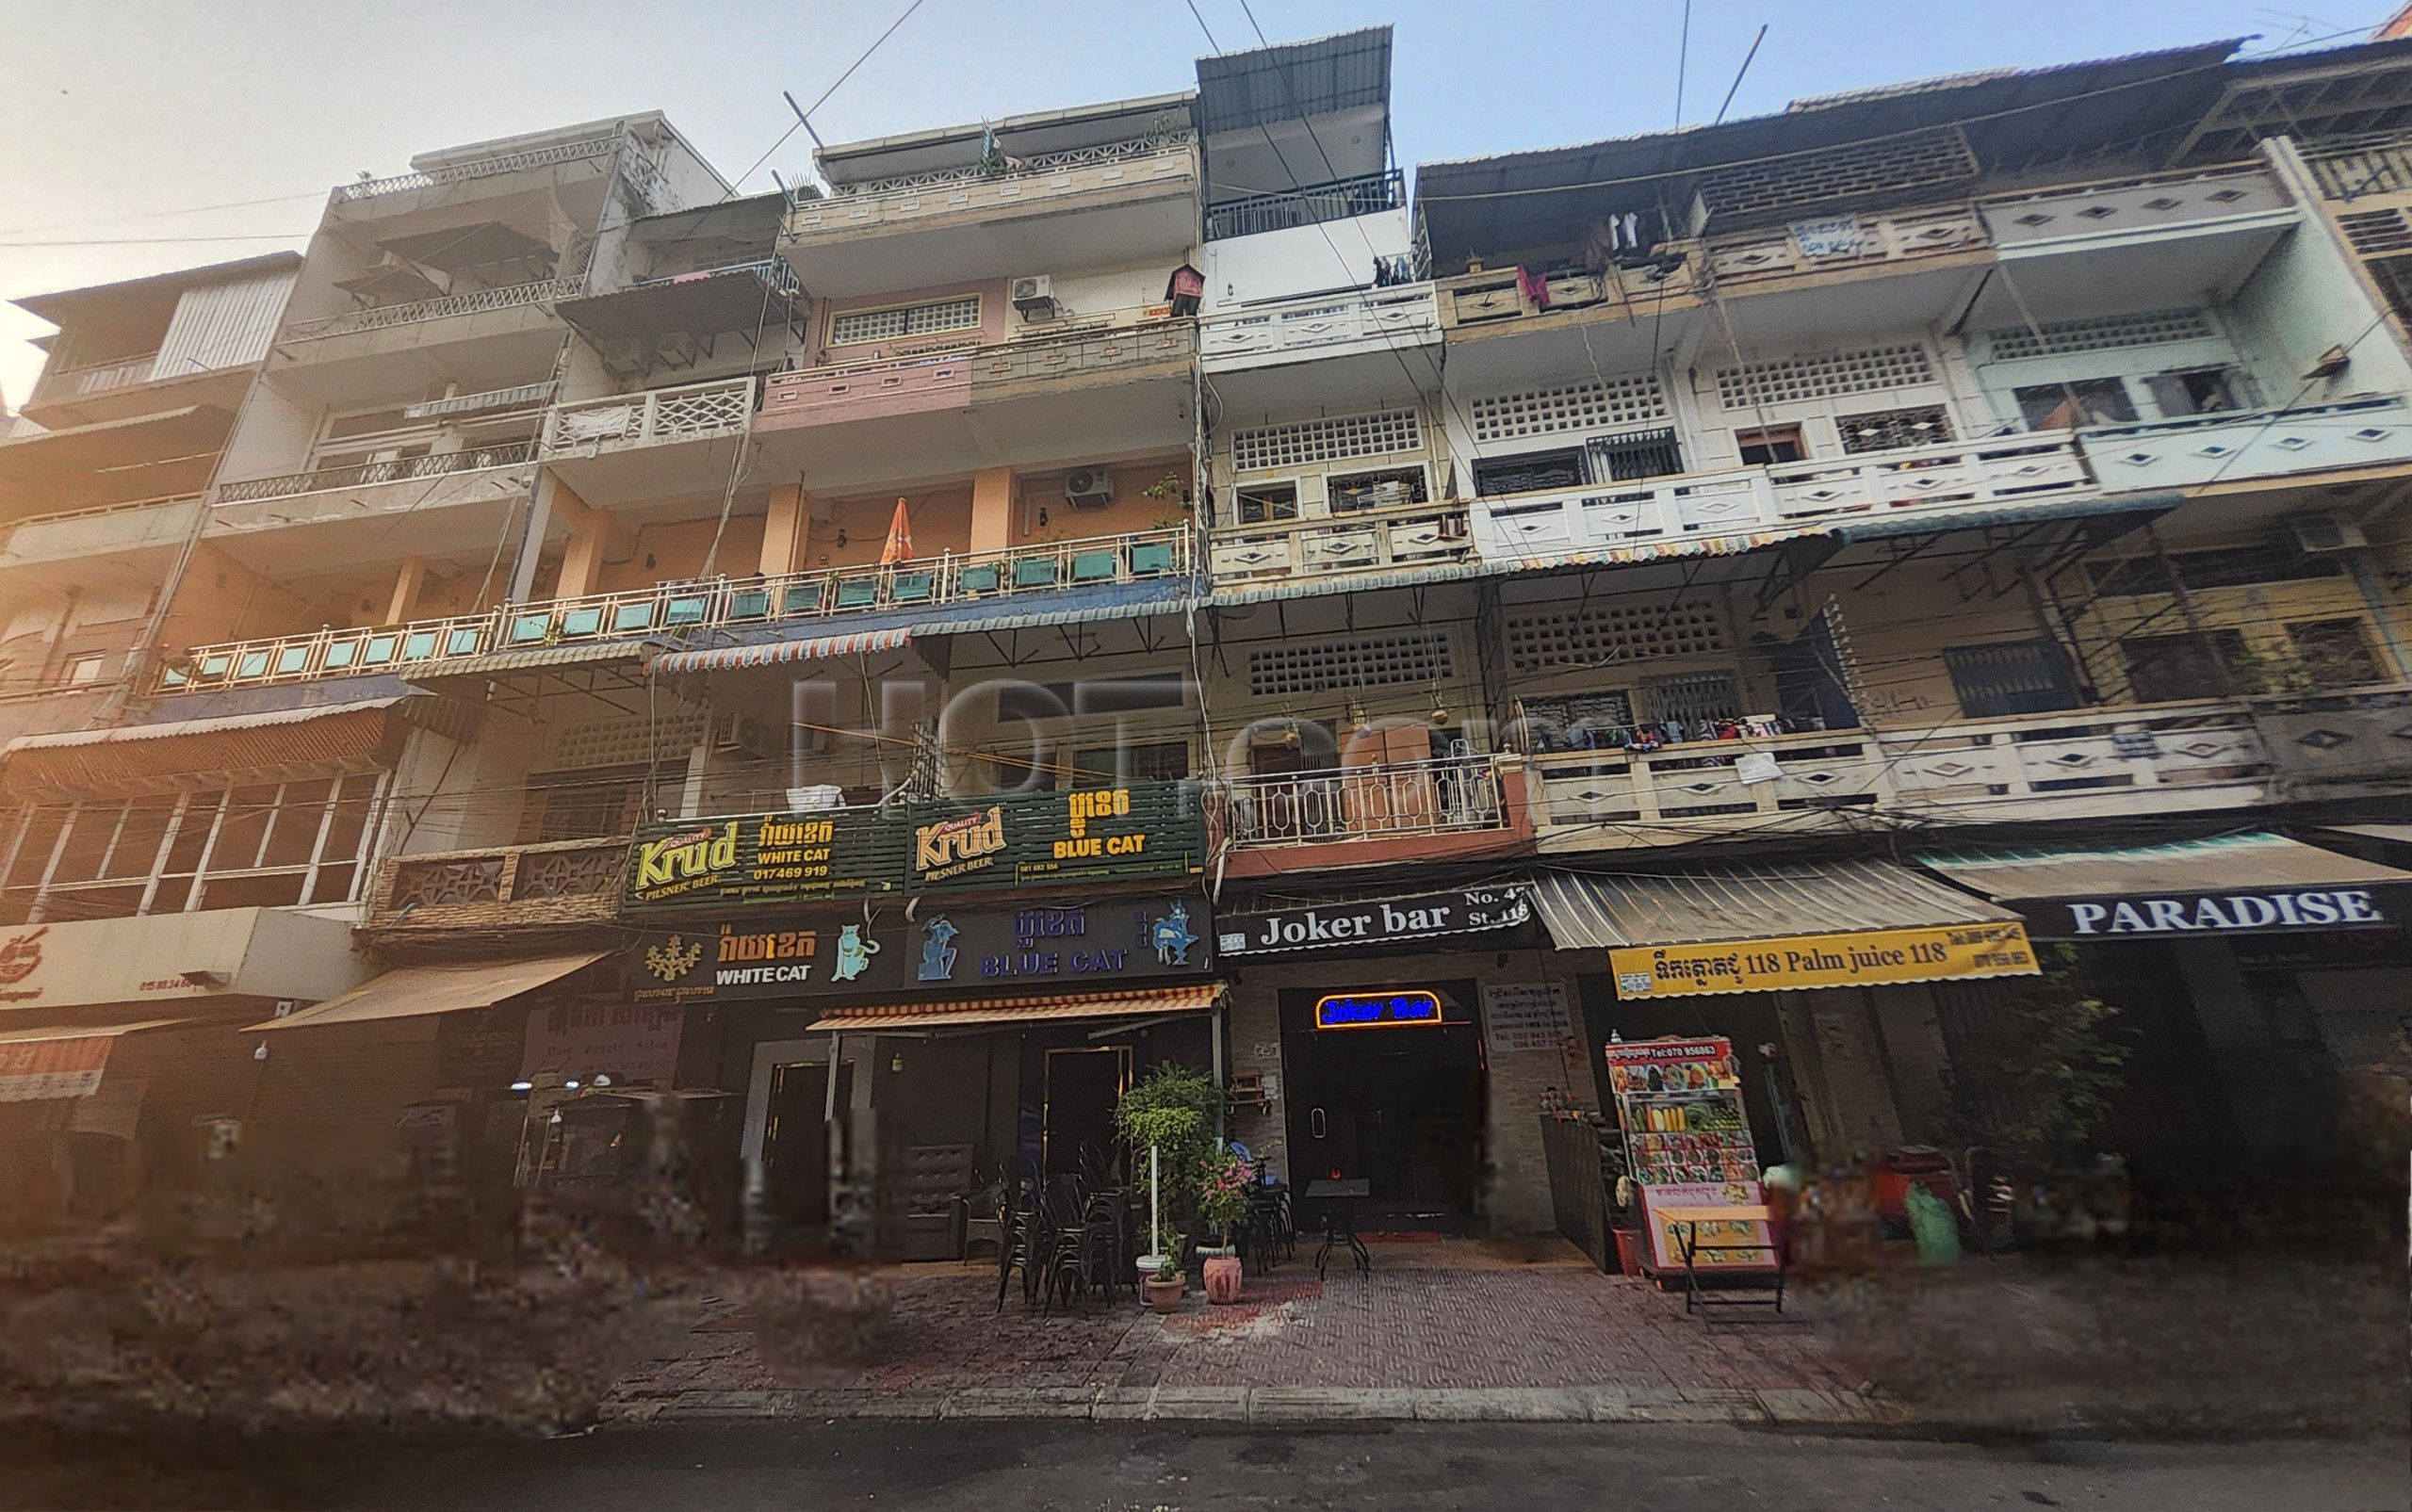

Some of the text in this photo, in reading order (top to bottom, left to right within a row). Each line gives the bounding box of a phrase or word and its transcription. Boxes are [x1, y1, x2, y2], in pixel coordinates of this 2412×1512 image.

[944, 815, 978, 832] QUALITY
[915, 805, 1007, 871] Krud
[1053, 835, 1145, 858] BLUE CAT
[635, 821, 739, 889] Krud
[758, 848, 830, 865] WHITE CAT
[805, 866, 827, 877] 919
[924, 864, 965, 882] PILSNER
[646, 881, 689, 901] PILSNER
[691, 875, 719, 890] BEER
[1463, 891, 1499, 906] No.
[1468, 912, 1495, 926] St.
[2066, 890, 2384, 935] PARADISE
[1261, 912, 1372, 946] Joker
[1379, 904, 1450, 934] bar
[980, 948, 1129, 978] BLUE CAT
[1745, 952, 1781, 974] 118
[1784, 948, 1846, 973] Palm
[1847, 944, 1905, 974] juice
[1909, 942, 1948, 964] 118
[716, 965, 812, 985] WHITE CAT
[1322, 997, 1433, 1024] Joker Bar
